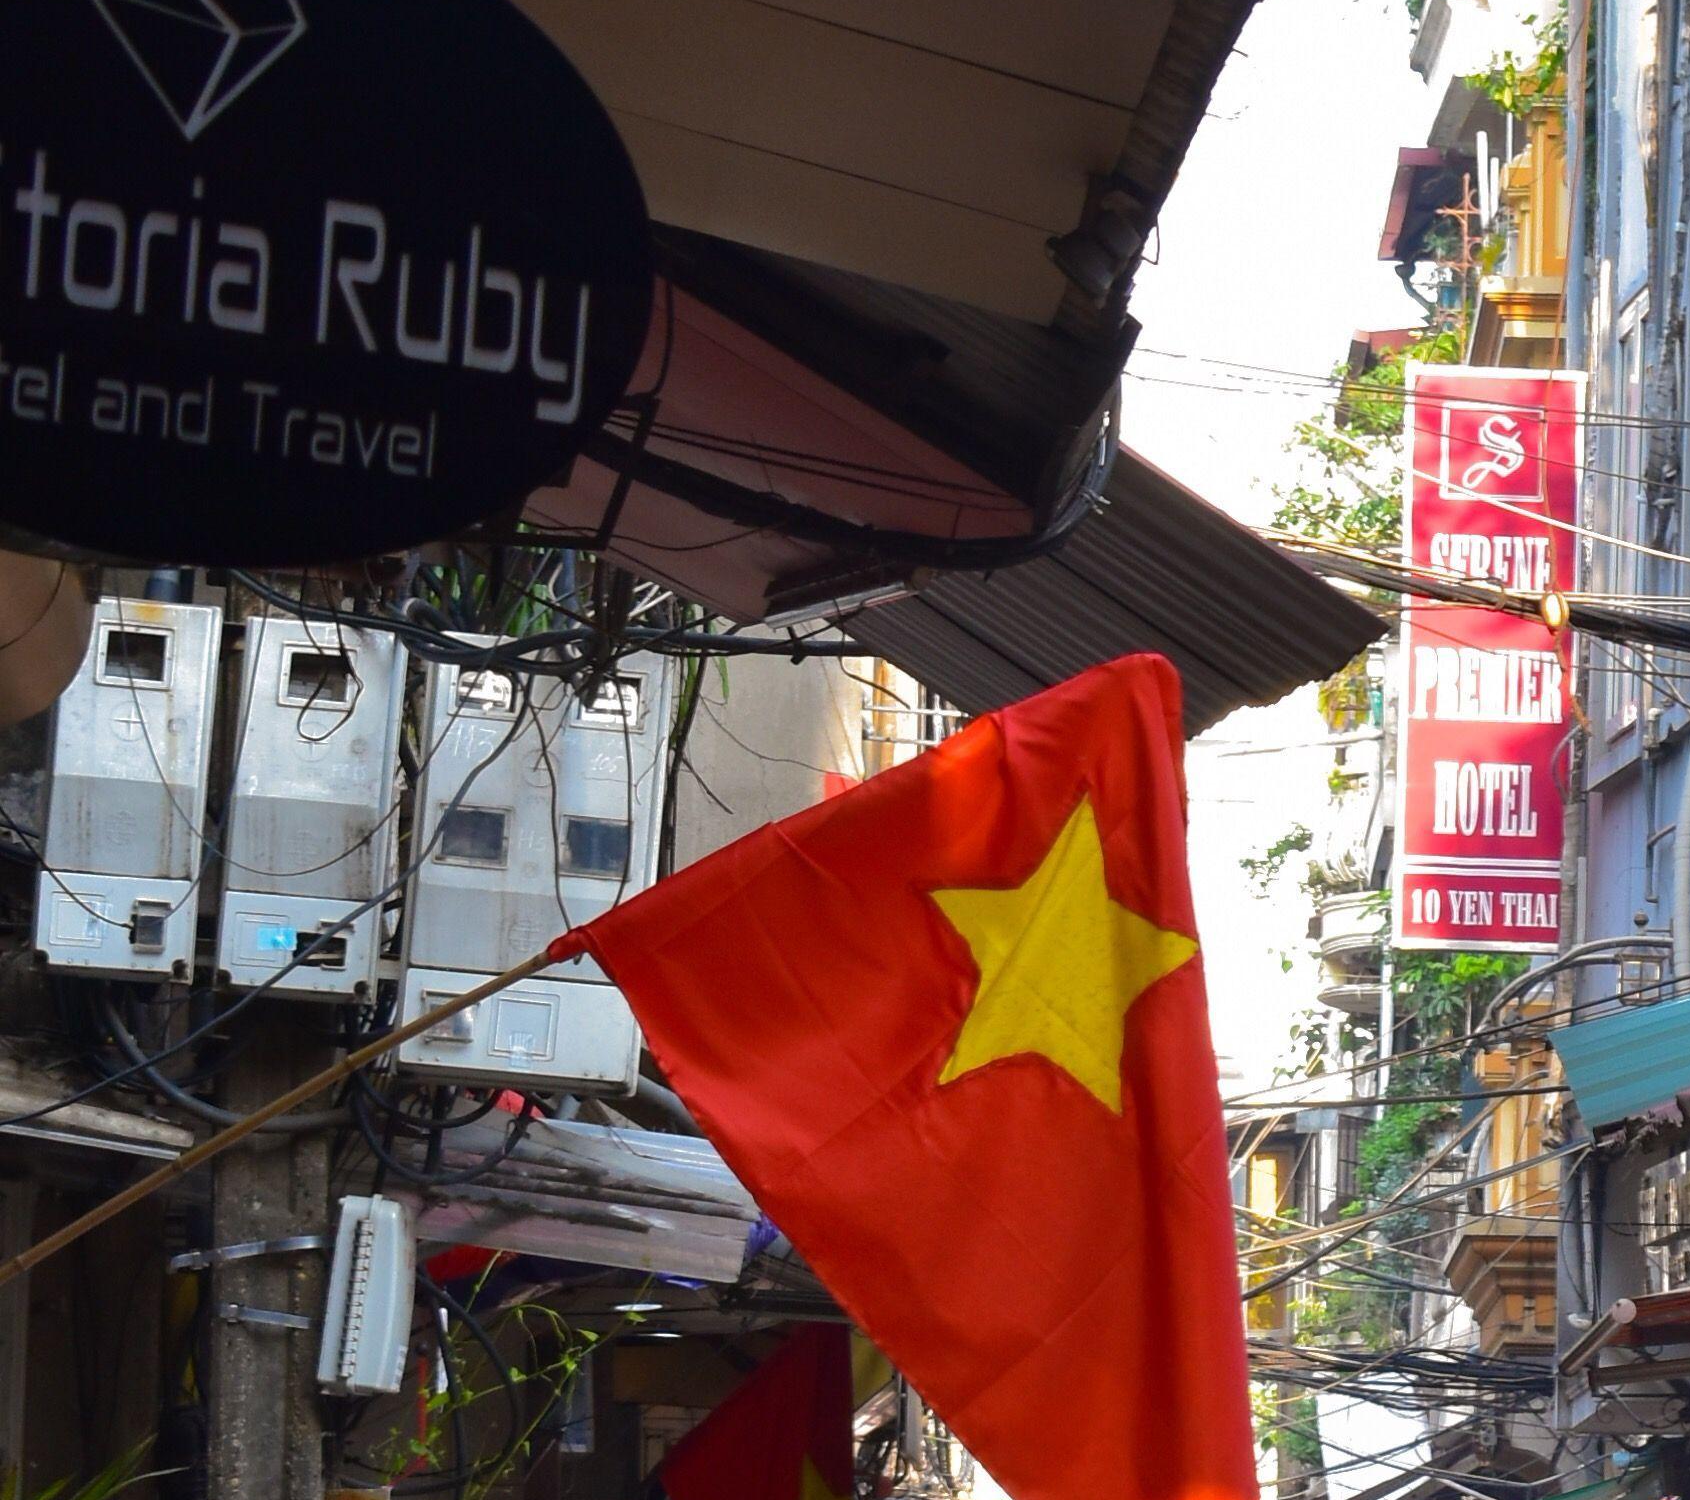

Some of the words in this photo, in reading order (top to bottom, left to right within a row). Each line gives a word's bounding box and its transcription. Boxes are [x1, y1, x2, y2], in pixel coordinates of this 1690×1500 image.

[316, 199, 590, 425] Ruby
[92, 374, 213, 446] and
[242, 380, 436, 479] Travel
[1430, 532, 1551, 593] SERENE
[1410, 645, 1563, 724] PREMIER
[1433, 760, 1538, 838] HOTEL
[1411, 888, 1441, 925] 10
[1447, 889, 1494, 926] YEN
[1501, 892, 1560, 929] THAI
